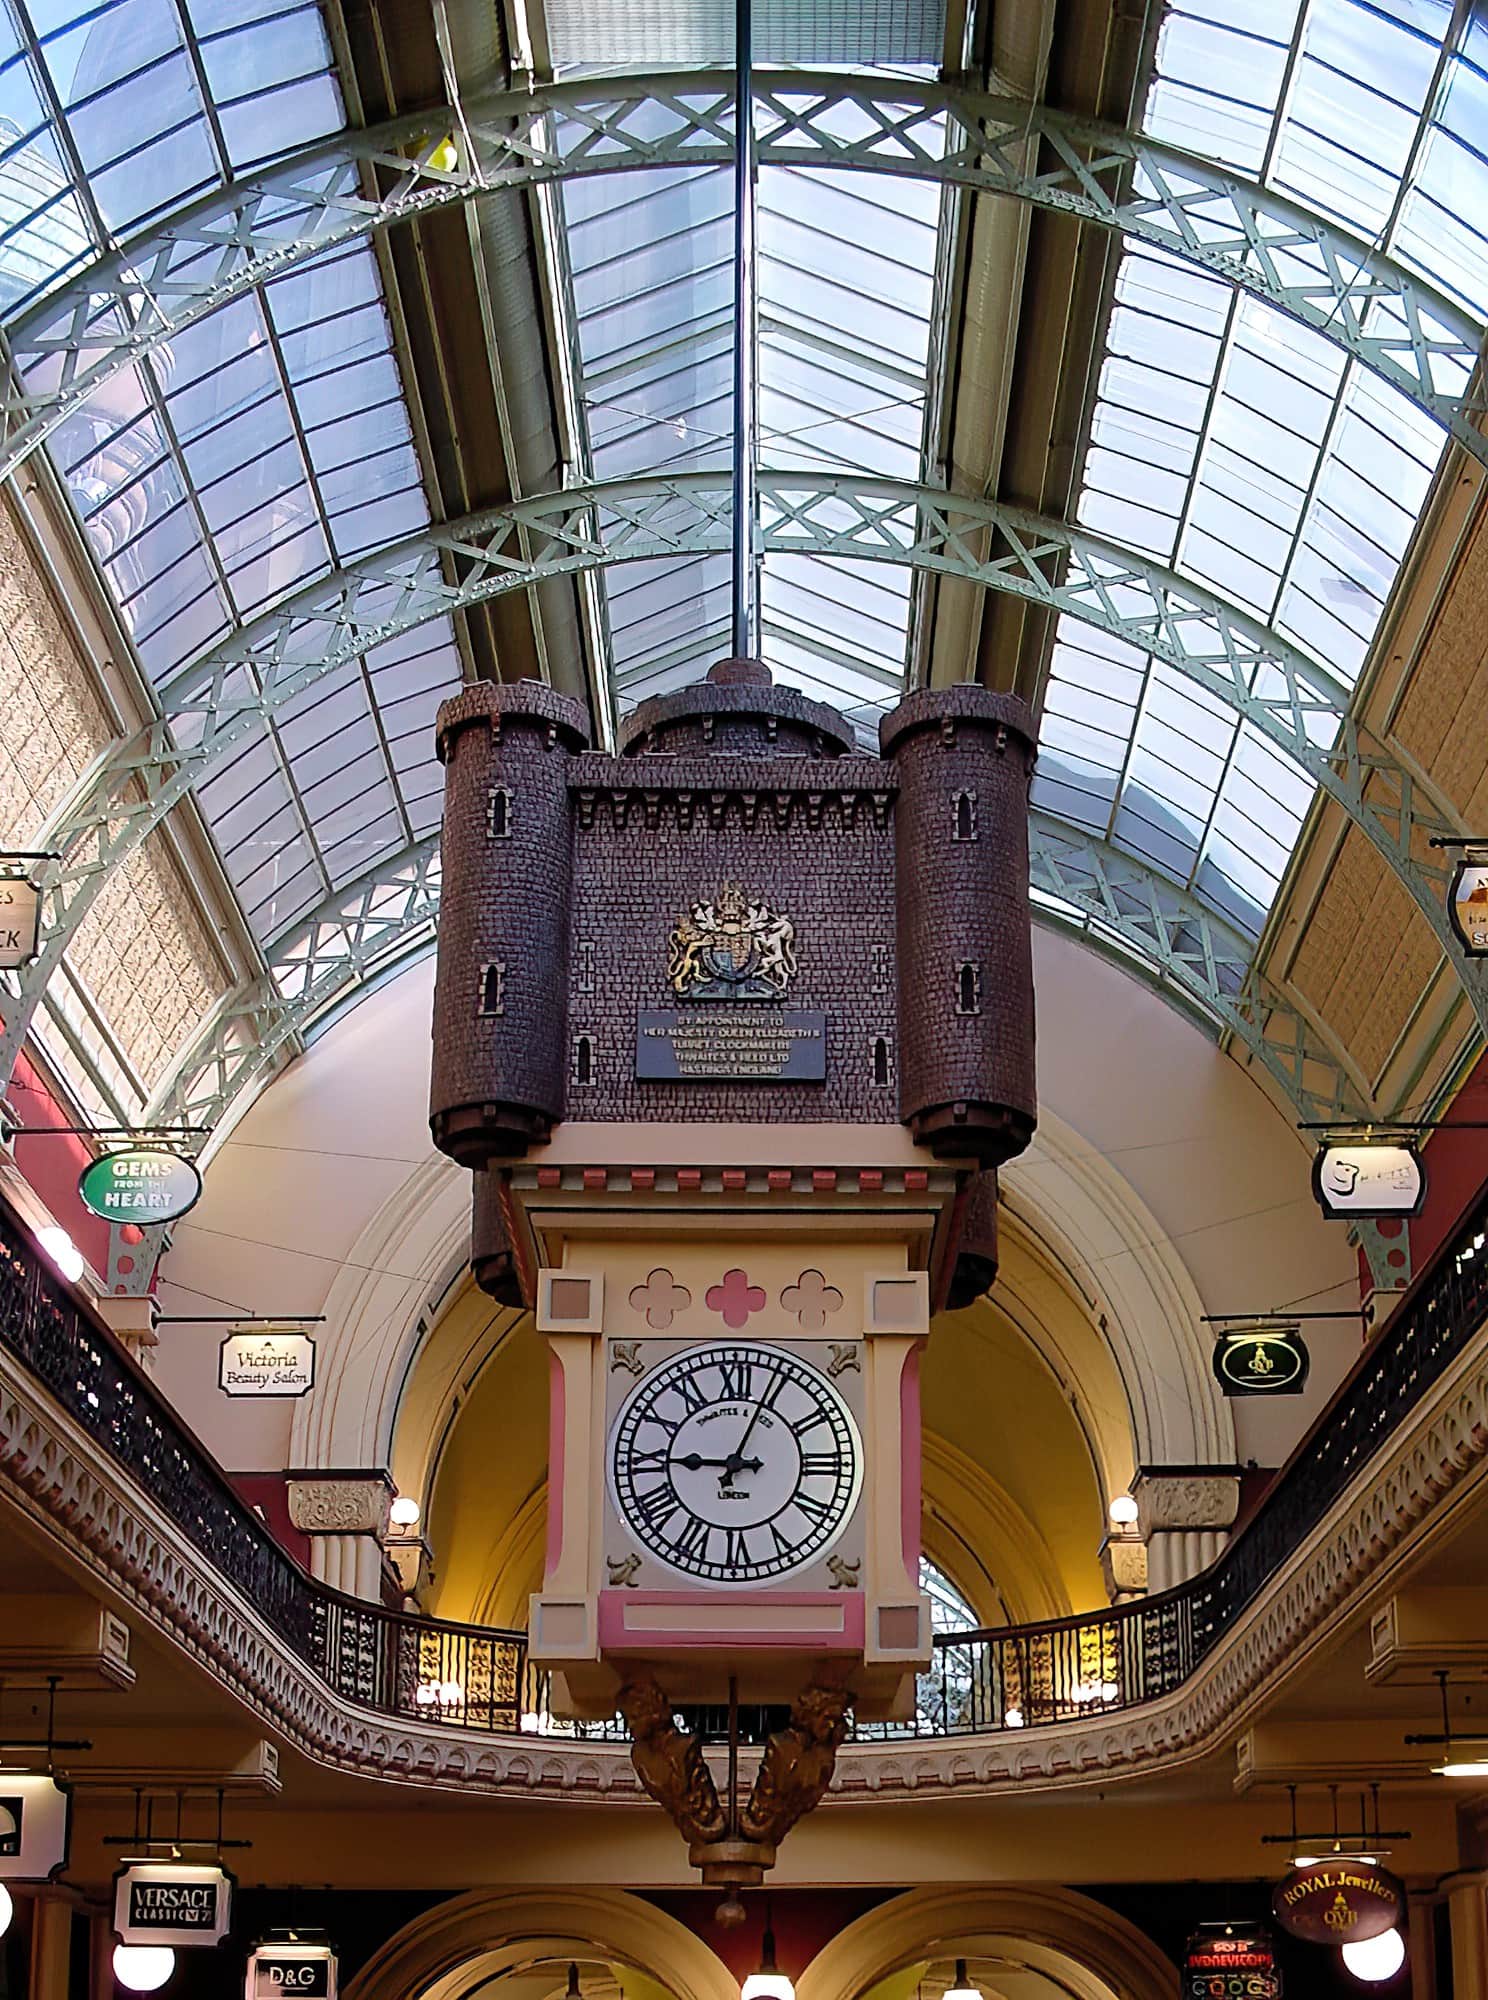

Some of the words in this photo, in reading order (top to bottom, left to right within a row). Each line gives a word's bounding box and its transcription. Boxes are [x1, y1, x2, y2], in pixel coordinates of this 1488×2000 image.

[0, 890, 14, 905] S
[1471, 932, 1488, 946] S
[112, 1161, 172, 1177] GEMS
[114, 1180, 143, 1189] FROM
[104, 1192, 172, 1208] HEART
[237, 1352, 298, 1367] Victoria
[227, 1371, 269, 1389] Beauty
[272, 1370, 307, 1384] Salon
[719, 1363, 752, 1400] XII
[669, 1372, 710, 1415] XI
[640, 1402, 681, 1440] X
[791, 1407, 830, 1438] II
[630, 1447, 668, 1476] IX
[800, 1453, 839, 1477] III
[1284, 1873, 1336, 1905] ROYAL
[1337, 1871, 1397, 1904] Jewellers
[136, 1888, 214, 1908] VERSACE
[135, 1908, 184, 1920] CLASSIC
[269, 1966, 315, 1985] D&G
